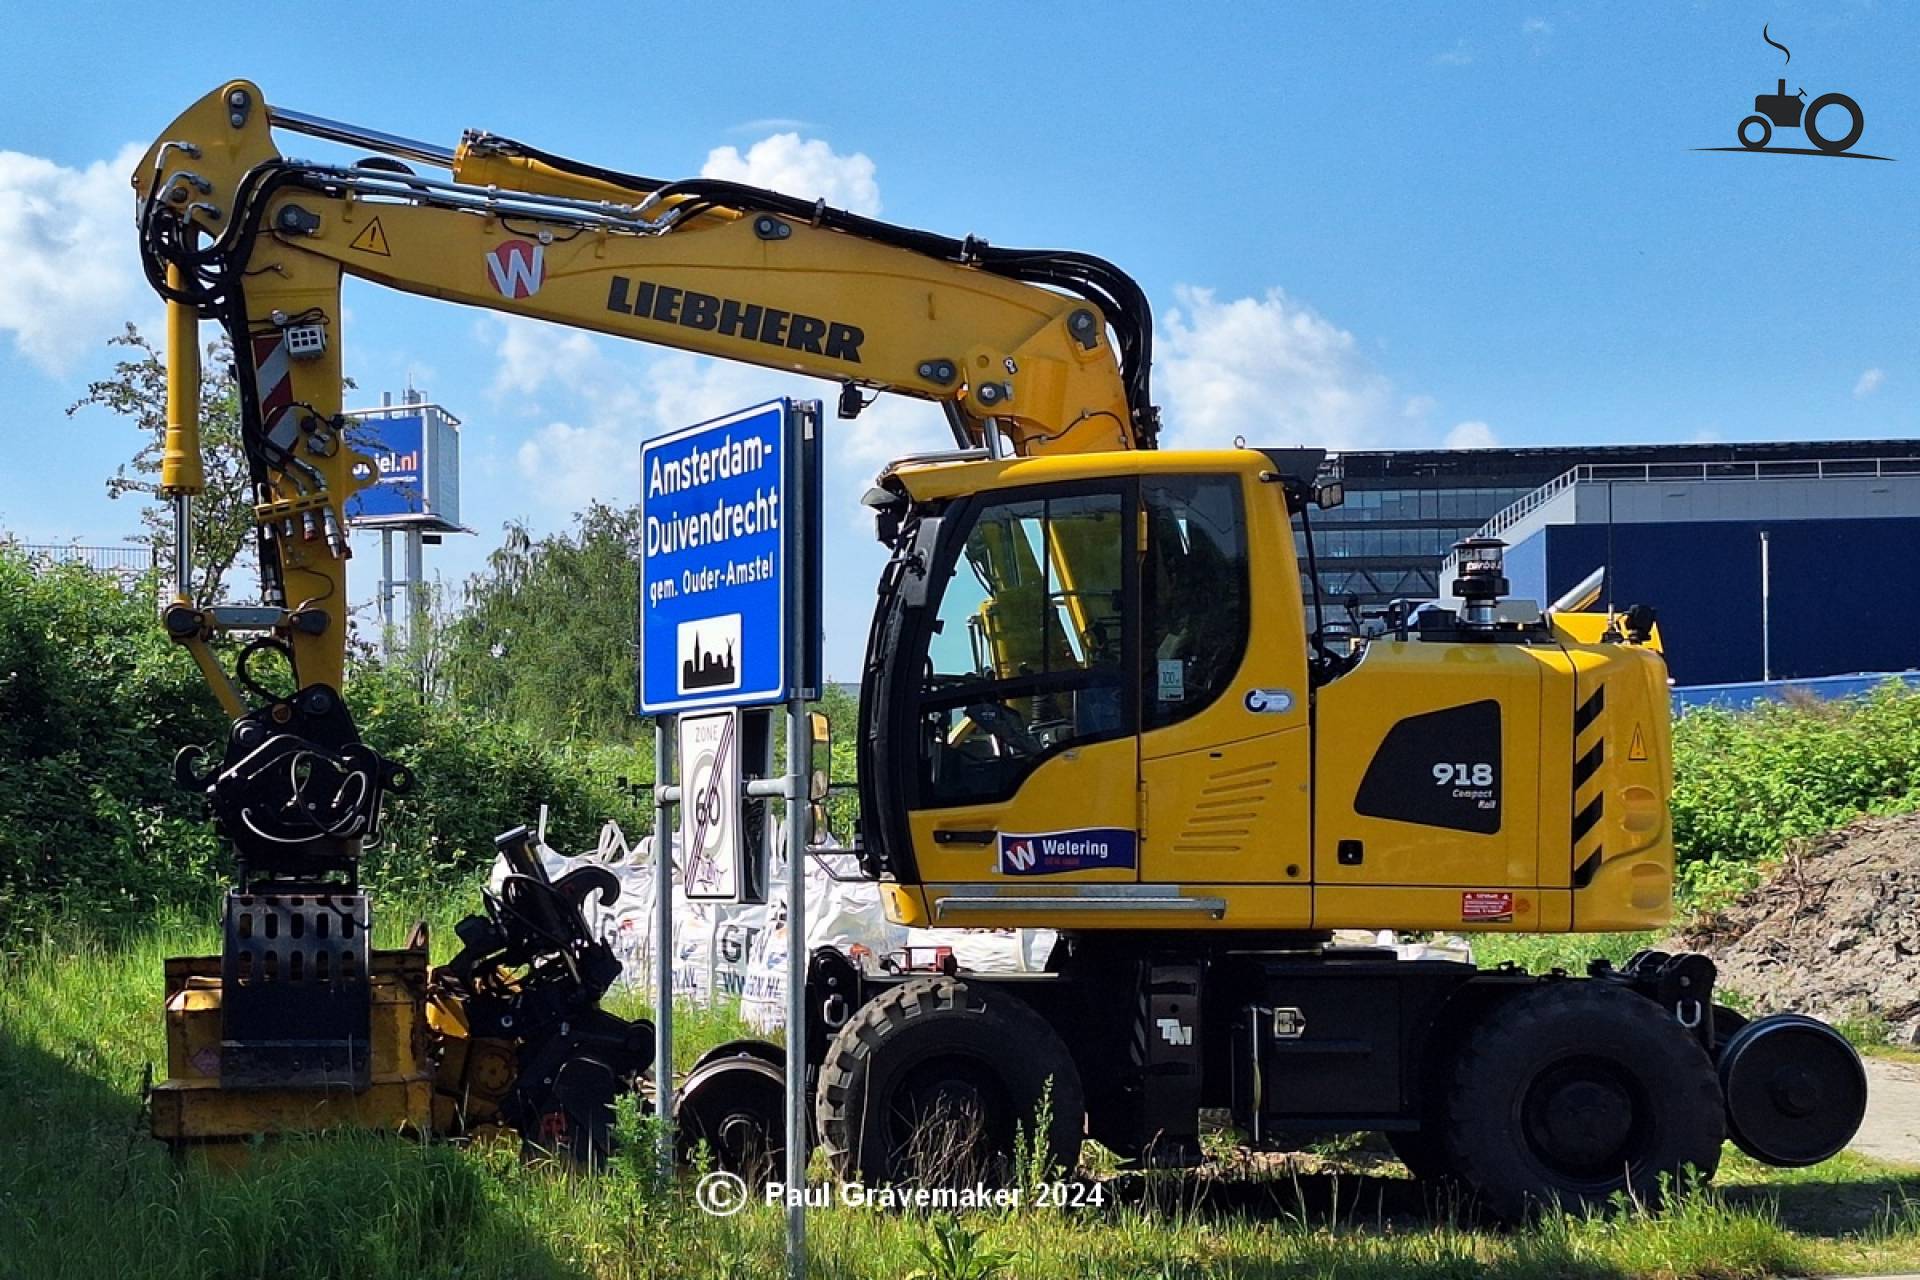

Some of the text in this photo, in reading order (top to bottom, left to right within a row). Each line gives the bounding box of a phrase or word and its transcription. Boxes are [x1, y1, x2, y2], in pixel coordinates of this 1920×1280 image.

[486, 245, 544, 298] W
[607, 275, 865, 363] LIEBHERR
[648, 433, 772, 499] Amsterdam-
[647, 485, 778, 558] Duivendrecht
[650, 551, 774, 608] gem. Ouder-Amstel
[695, 725, 719, 743] ZONE
[1432, 763, 1493, 786] 918
[1452, 789, 1493, 799] Compact
[695, 786, 721, 826] 60
[1042, 839, 1108, 859] Wetering
